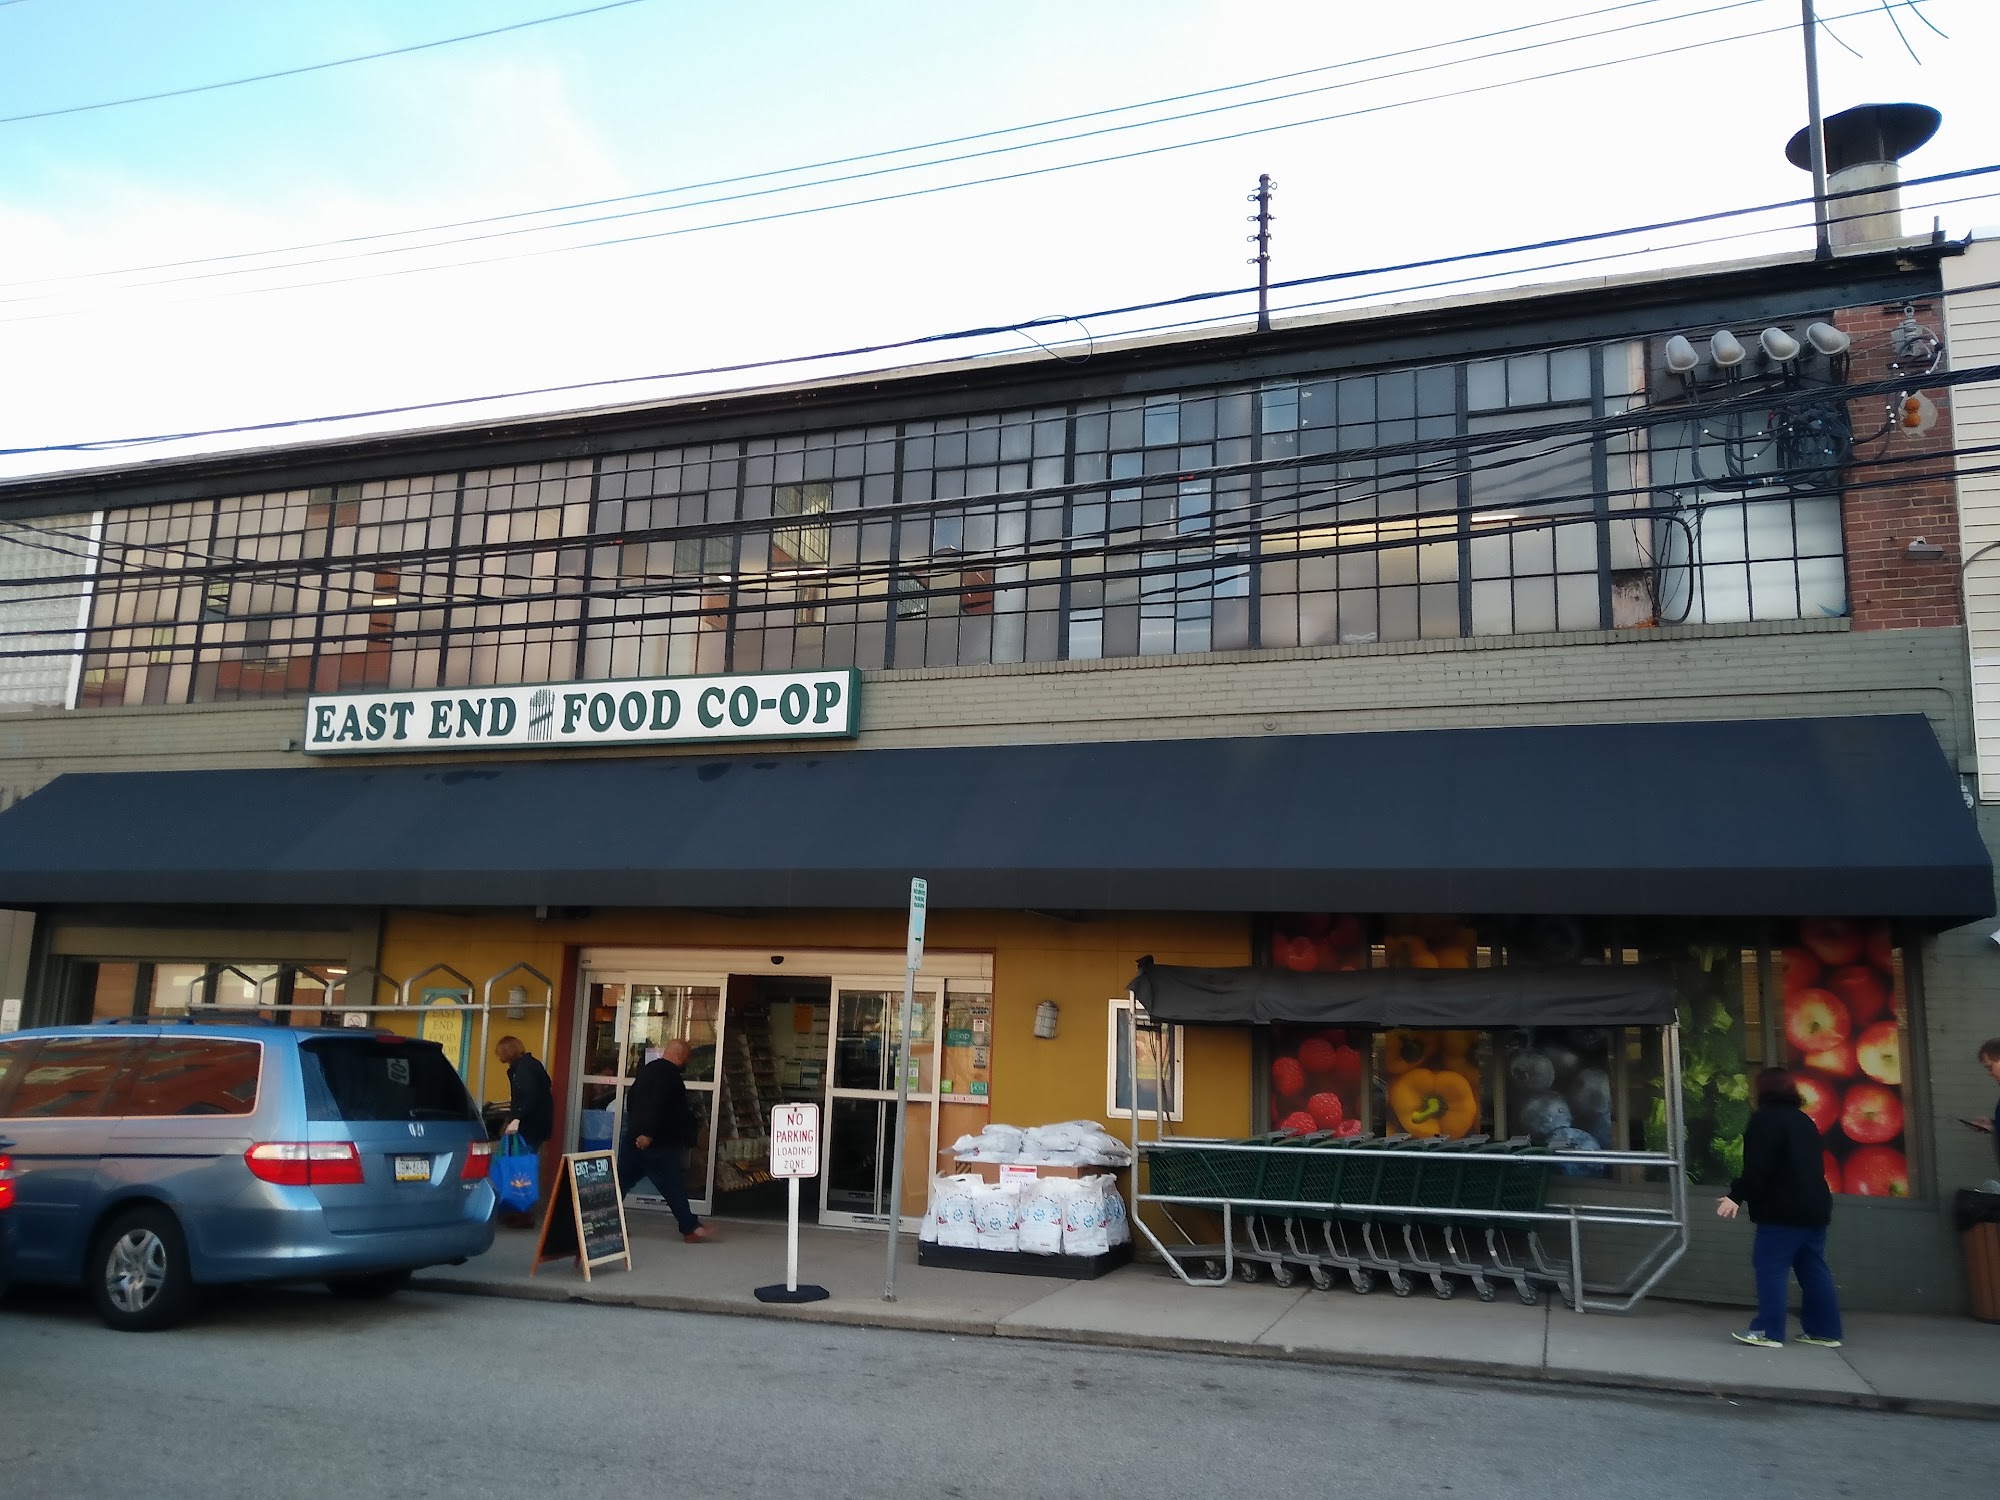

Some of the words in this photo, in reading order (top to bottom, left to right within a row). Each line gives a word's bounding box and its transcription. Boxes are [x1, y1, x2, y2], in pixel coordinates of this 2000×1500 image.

[312, 701, 414, 743] EAST
[428, 696, 516, 738] END
[561, 690, 681, 733] FOOD
[698, 681, 841, 728] CO-OP
[432, 1009, 455, 1018] EAST
[433, 1020, 454, 1029] END
[429, 1033, 456, 1042] FOOD
[787, 1113, 803, 1126] NO
[776, 1130, 814, 1143] PARKING
[777, 1147, 812, 1156] LOADING
[596, 1158, 609, 1172] END
[784, 1160, 806, 1169] ZONE
